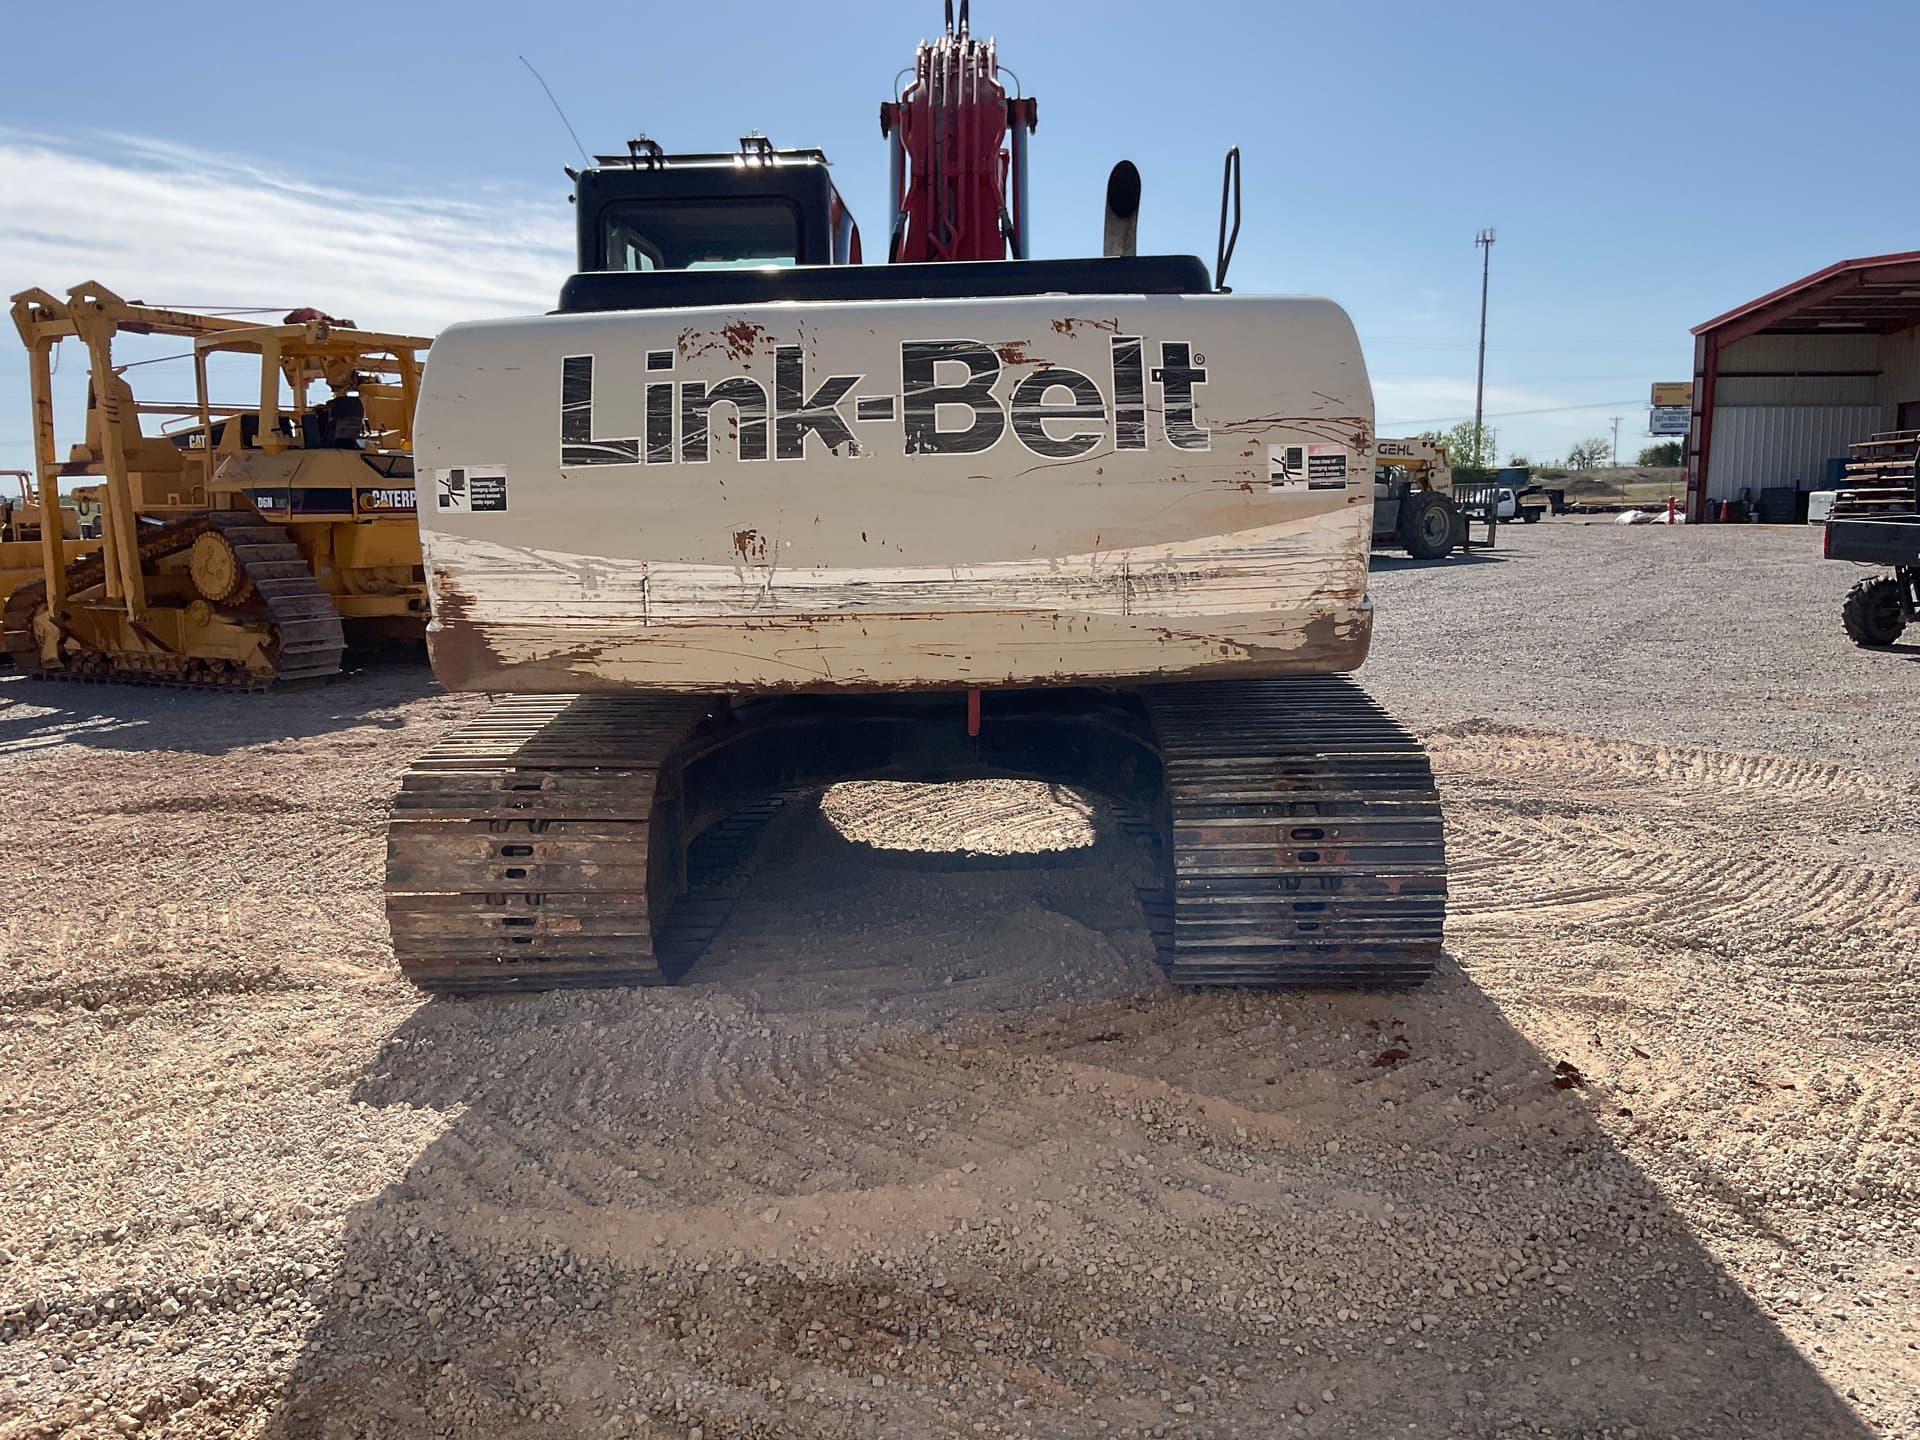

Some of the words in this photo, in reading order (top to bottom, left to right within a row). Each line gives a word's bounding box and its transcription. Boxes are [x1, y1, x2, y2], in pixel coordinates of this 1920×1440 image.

[560, 336, 1211, 469] Link-Belt
[189, 434, 206, 449] CAT
[1378, 443, 1415, 456] GEHL
